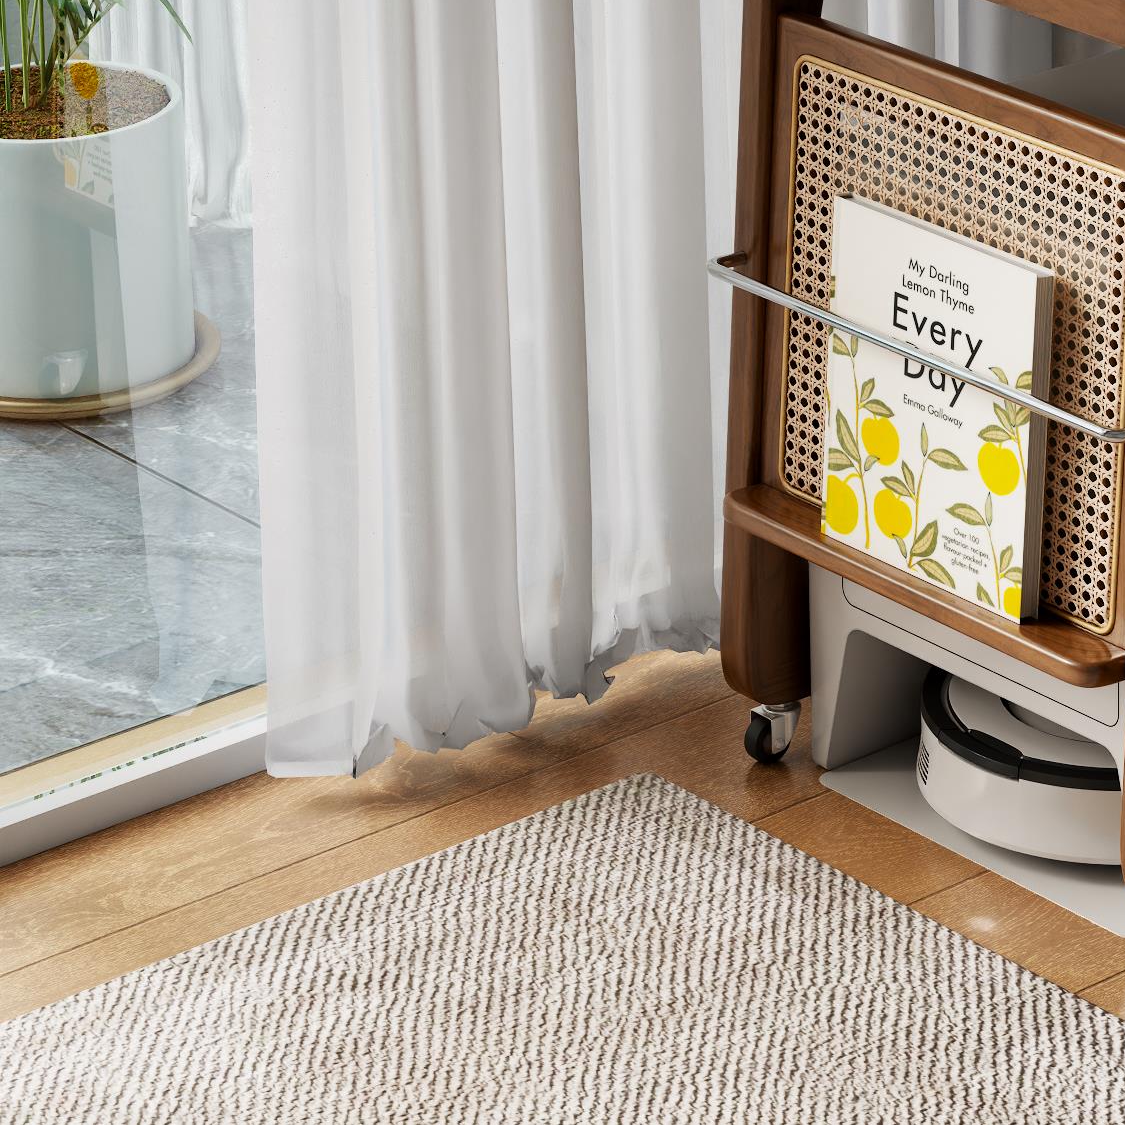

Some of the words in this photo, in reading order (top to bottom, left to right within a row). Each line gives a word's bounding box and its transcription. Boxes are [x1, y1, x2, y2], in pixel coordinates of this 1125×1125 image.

[902, 274, 936, 299] Lemon
[940, 288, 975, 315] Thyme
[908, 257, 925, 277] My
[929, 264, 969, 296] Darling
[892, 291, 983, 369] Every
[903, 393, 926, 412] Emma
[927, 404, 964, 429] Galloway
